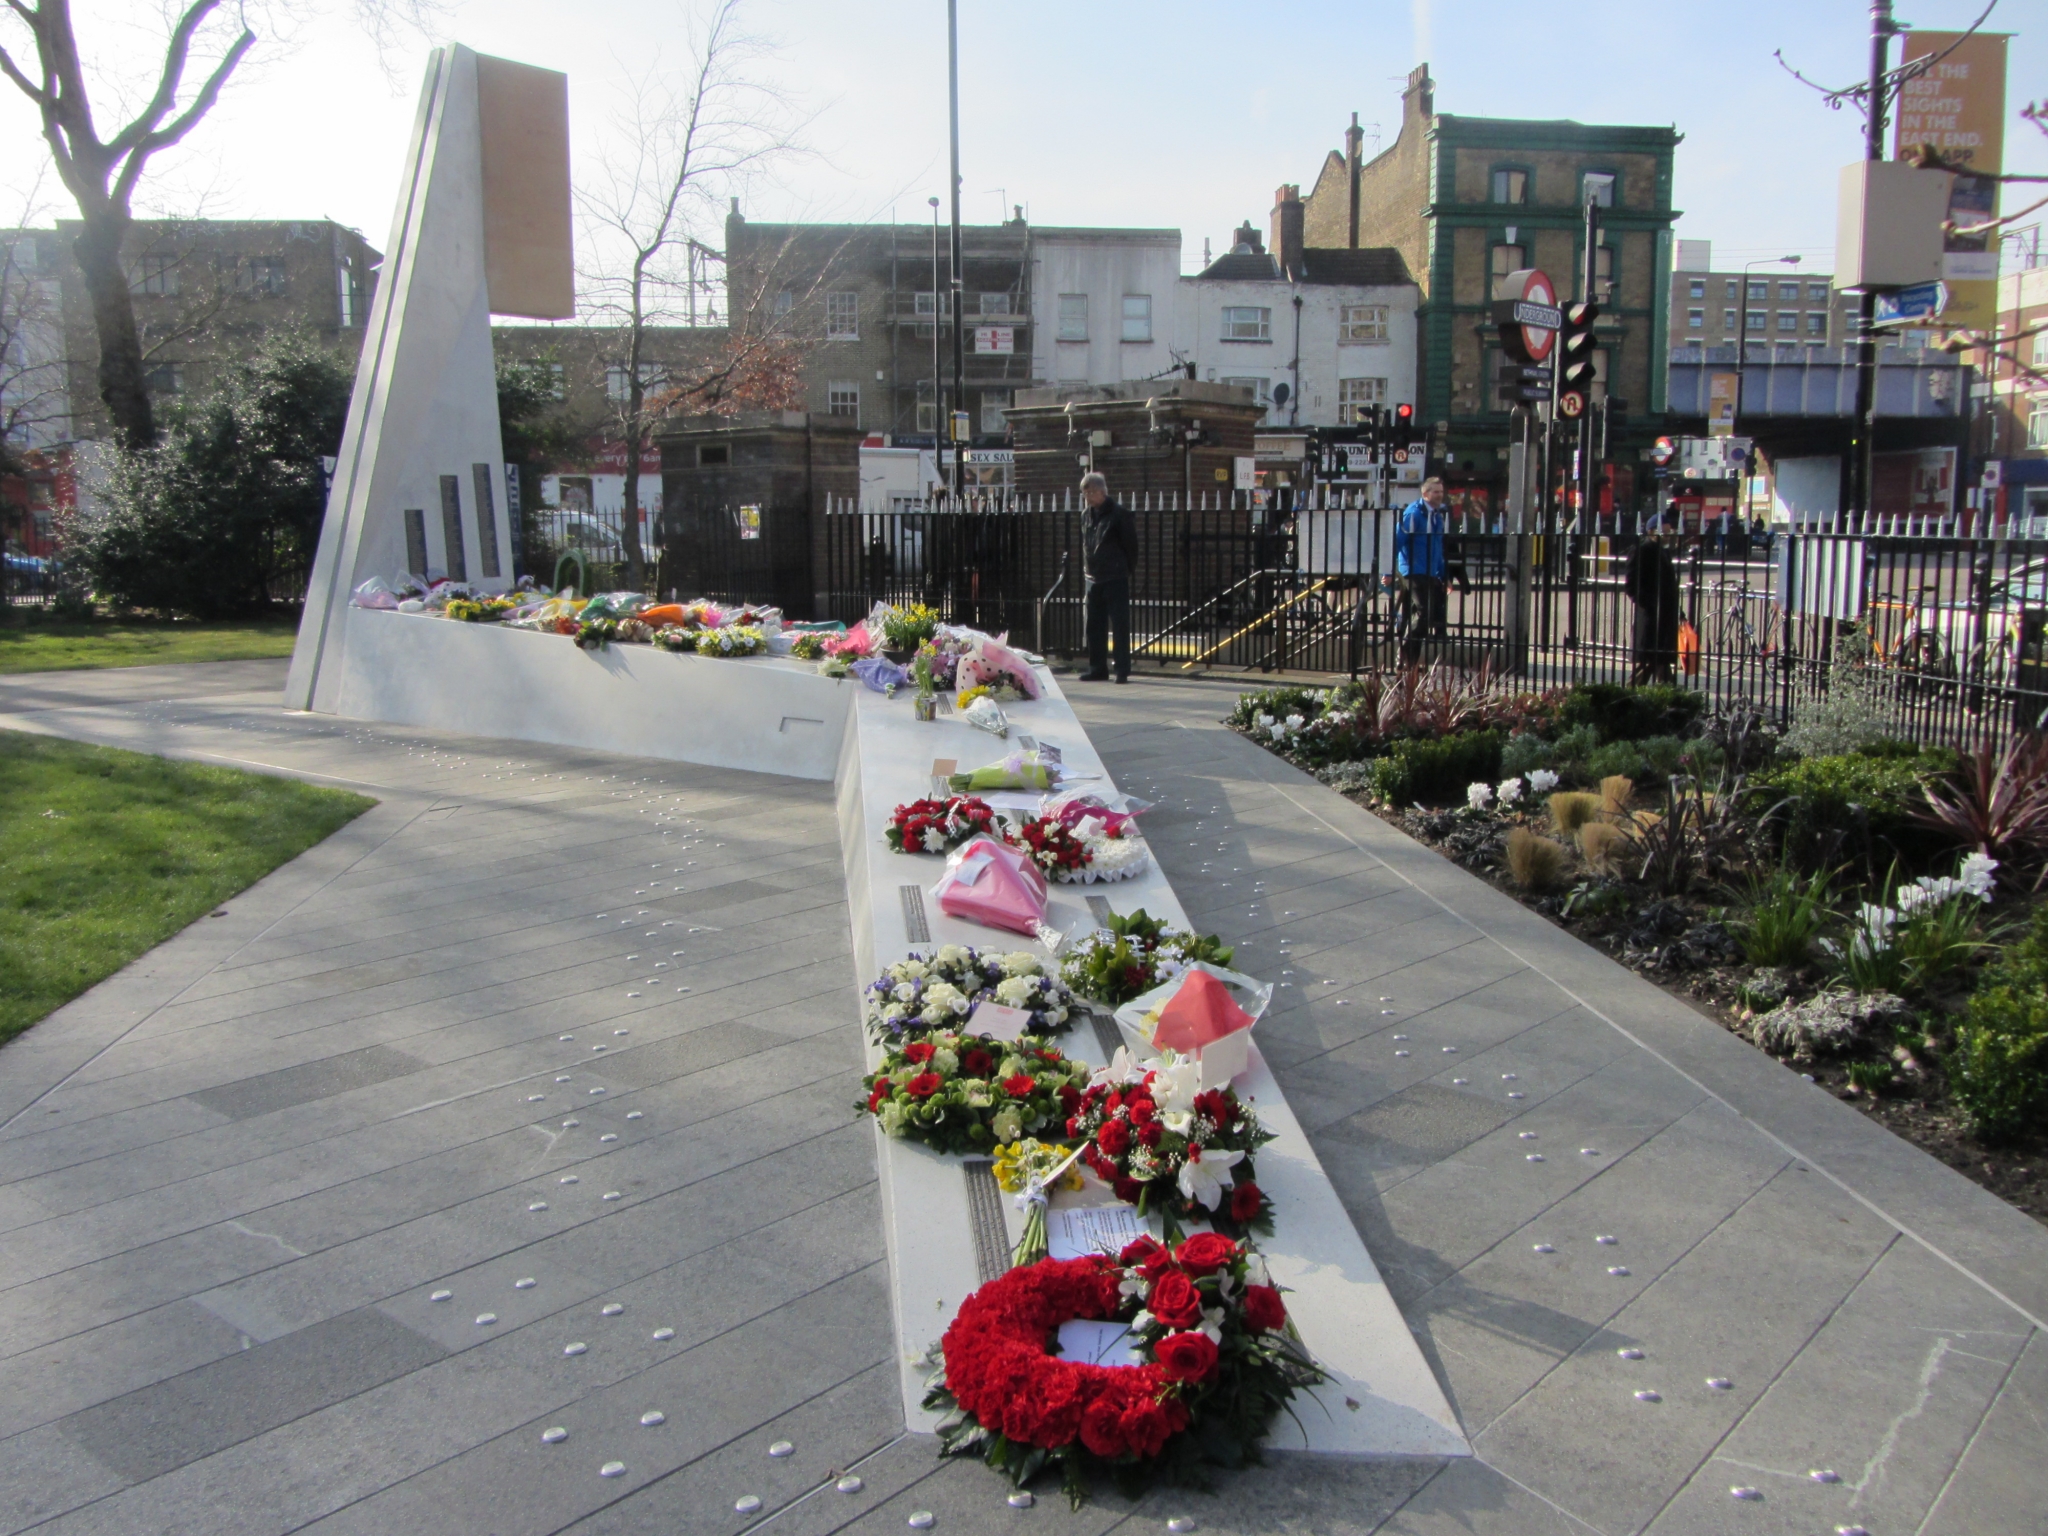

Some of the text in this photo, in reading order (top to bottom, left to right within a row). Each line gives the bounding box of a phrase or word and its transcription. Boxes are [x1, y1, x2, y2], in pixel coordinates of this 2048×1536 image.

[1939, 64, 1969, 78] THE
[1904, 80, 1942, 95] BEST
[1902, 97, 1963, 113] SIGHTS
[1902, 114, 1957, 130] IN THE
[1900, 131, 1940, 147] EAST
[1513, 301, 1562, 330] UNDERGROUND
